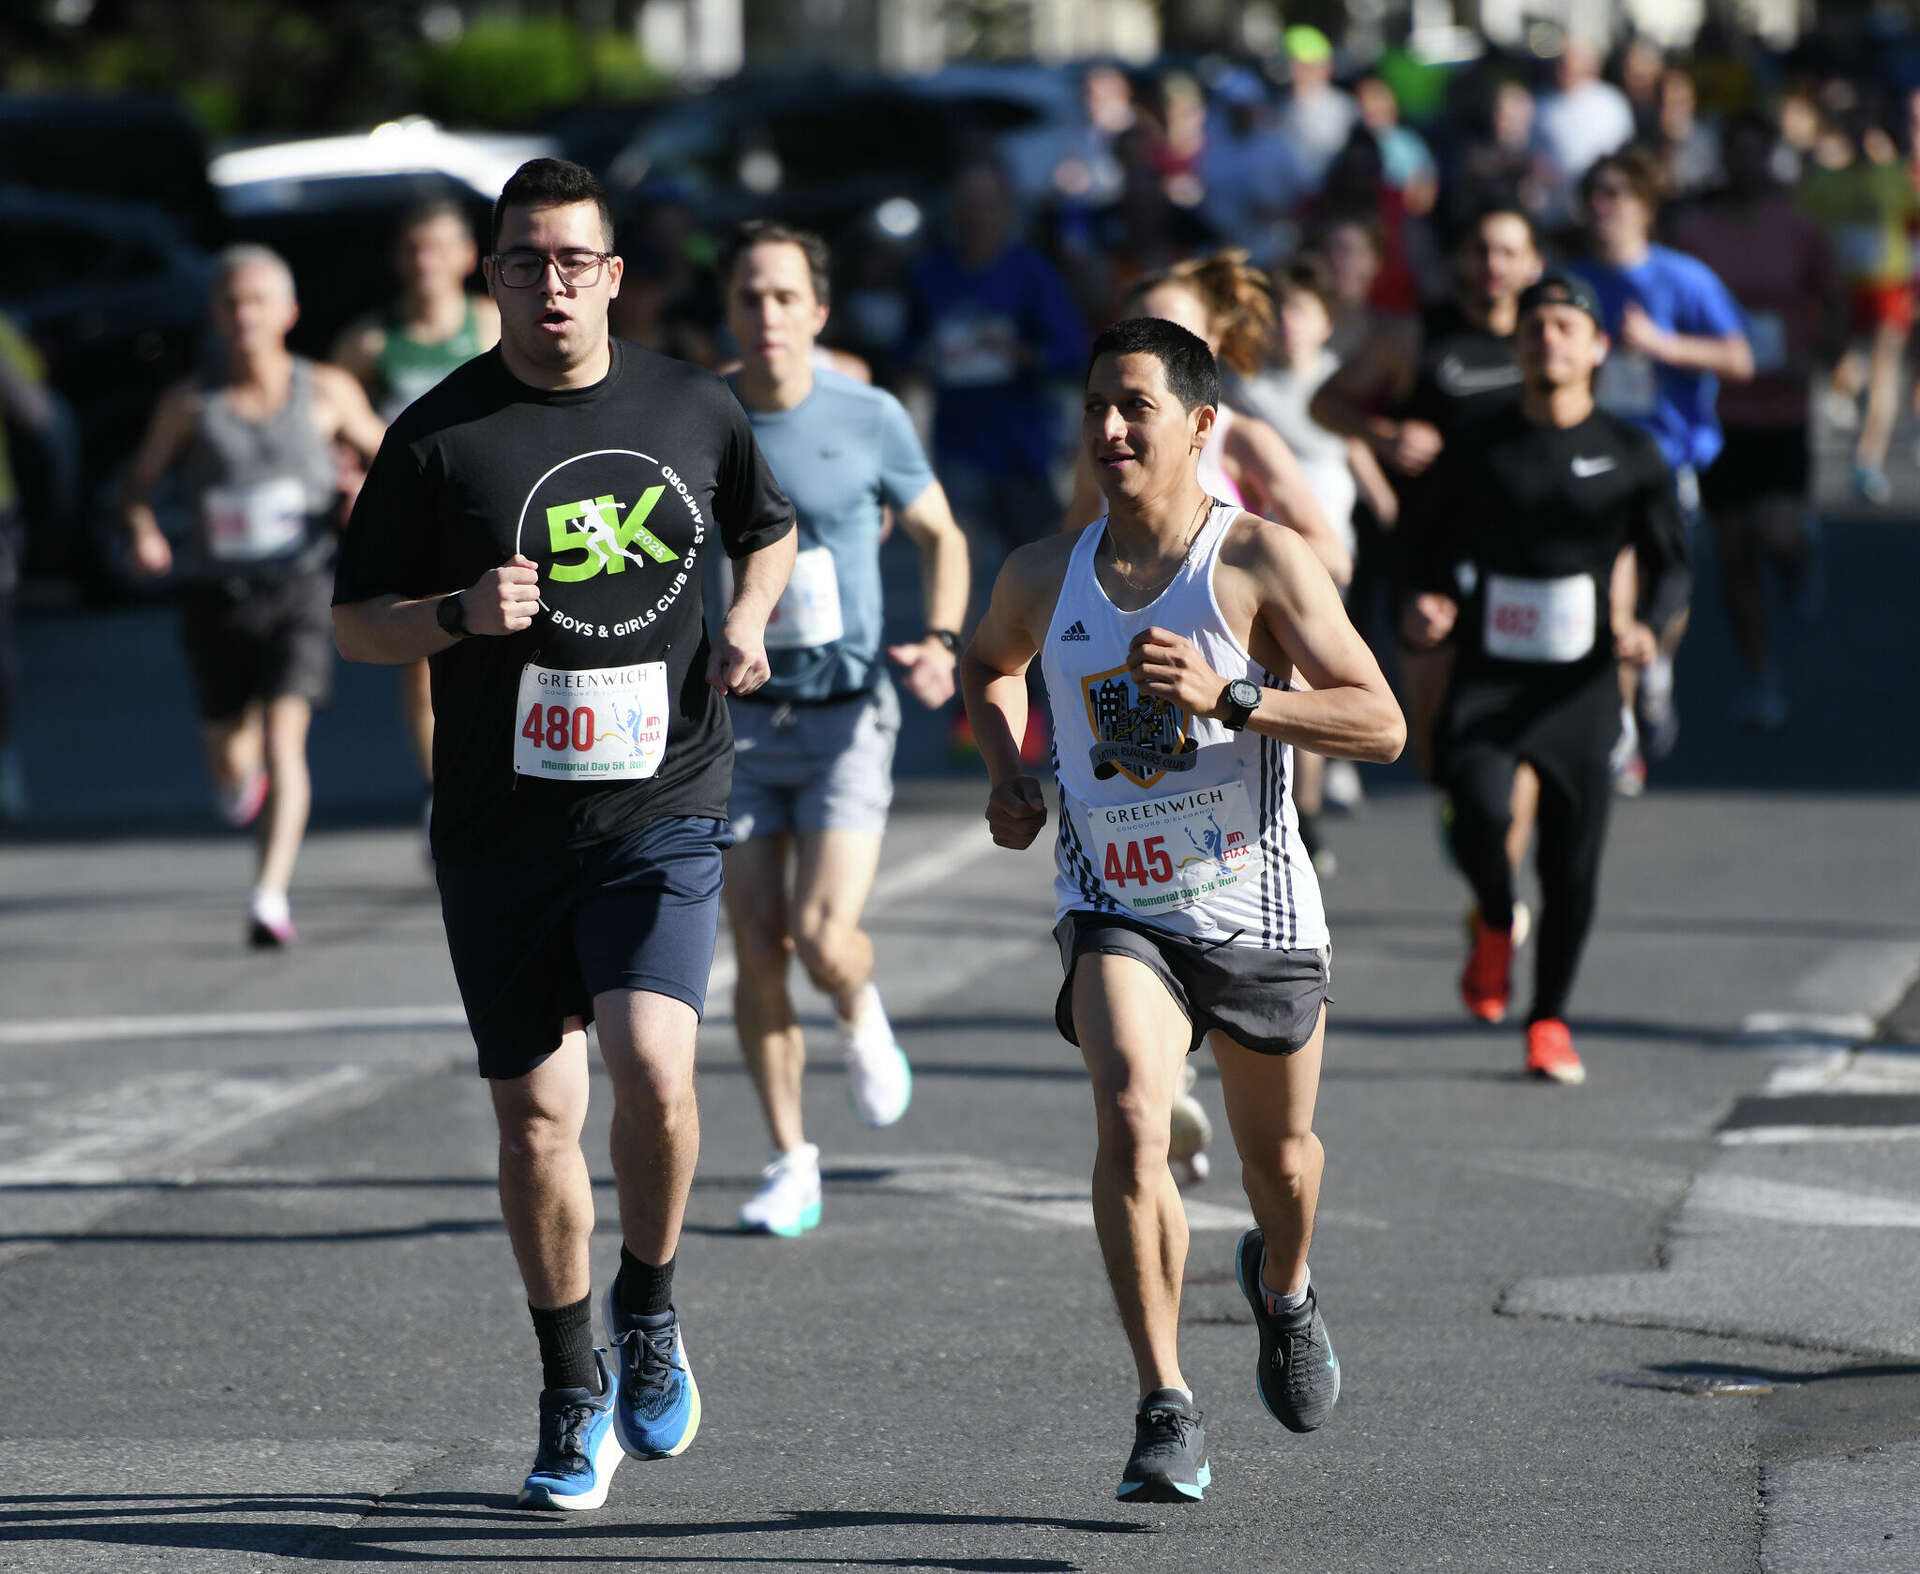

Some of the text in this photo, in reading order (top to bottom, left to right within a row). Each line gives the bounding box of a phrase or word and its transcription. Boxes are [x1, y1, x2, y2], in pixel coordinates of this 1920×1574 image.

[546, 485, 680, 583] 5K
[634, 529, 666, 559] 2025
[551, 465, 705, 638] BOYS & GIRLS CLUB OF STAMFORD
[1060, 632, 1090, 642] adidas
[537, 669, 648, 688] GREENWICH
[521, 702, 595, 752] 480
[541, 759, 589, 772] Memorial
[591, 760, 611, 772] Day
[612, 760, 625, 770] 5K
[1105, 789, 1224, 824] GREENWICH
[1103, 835, 1174, 888] 445
[1223, 845, 1250, 862] FIXX
[1132, 892, 1179, 908] Memorial
[1180, 885, 1199, 899] Day
[1218, 875, 1238, 888] Run
